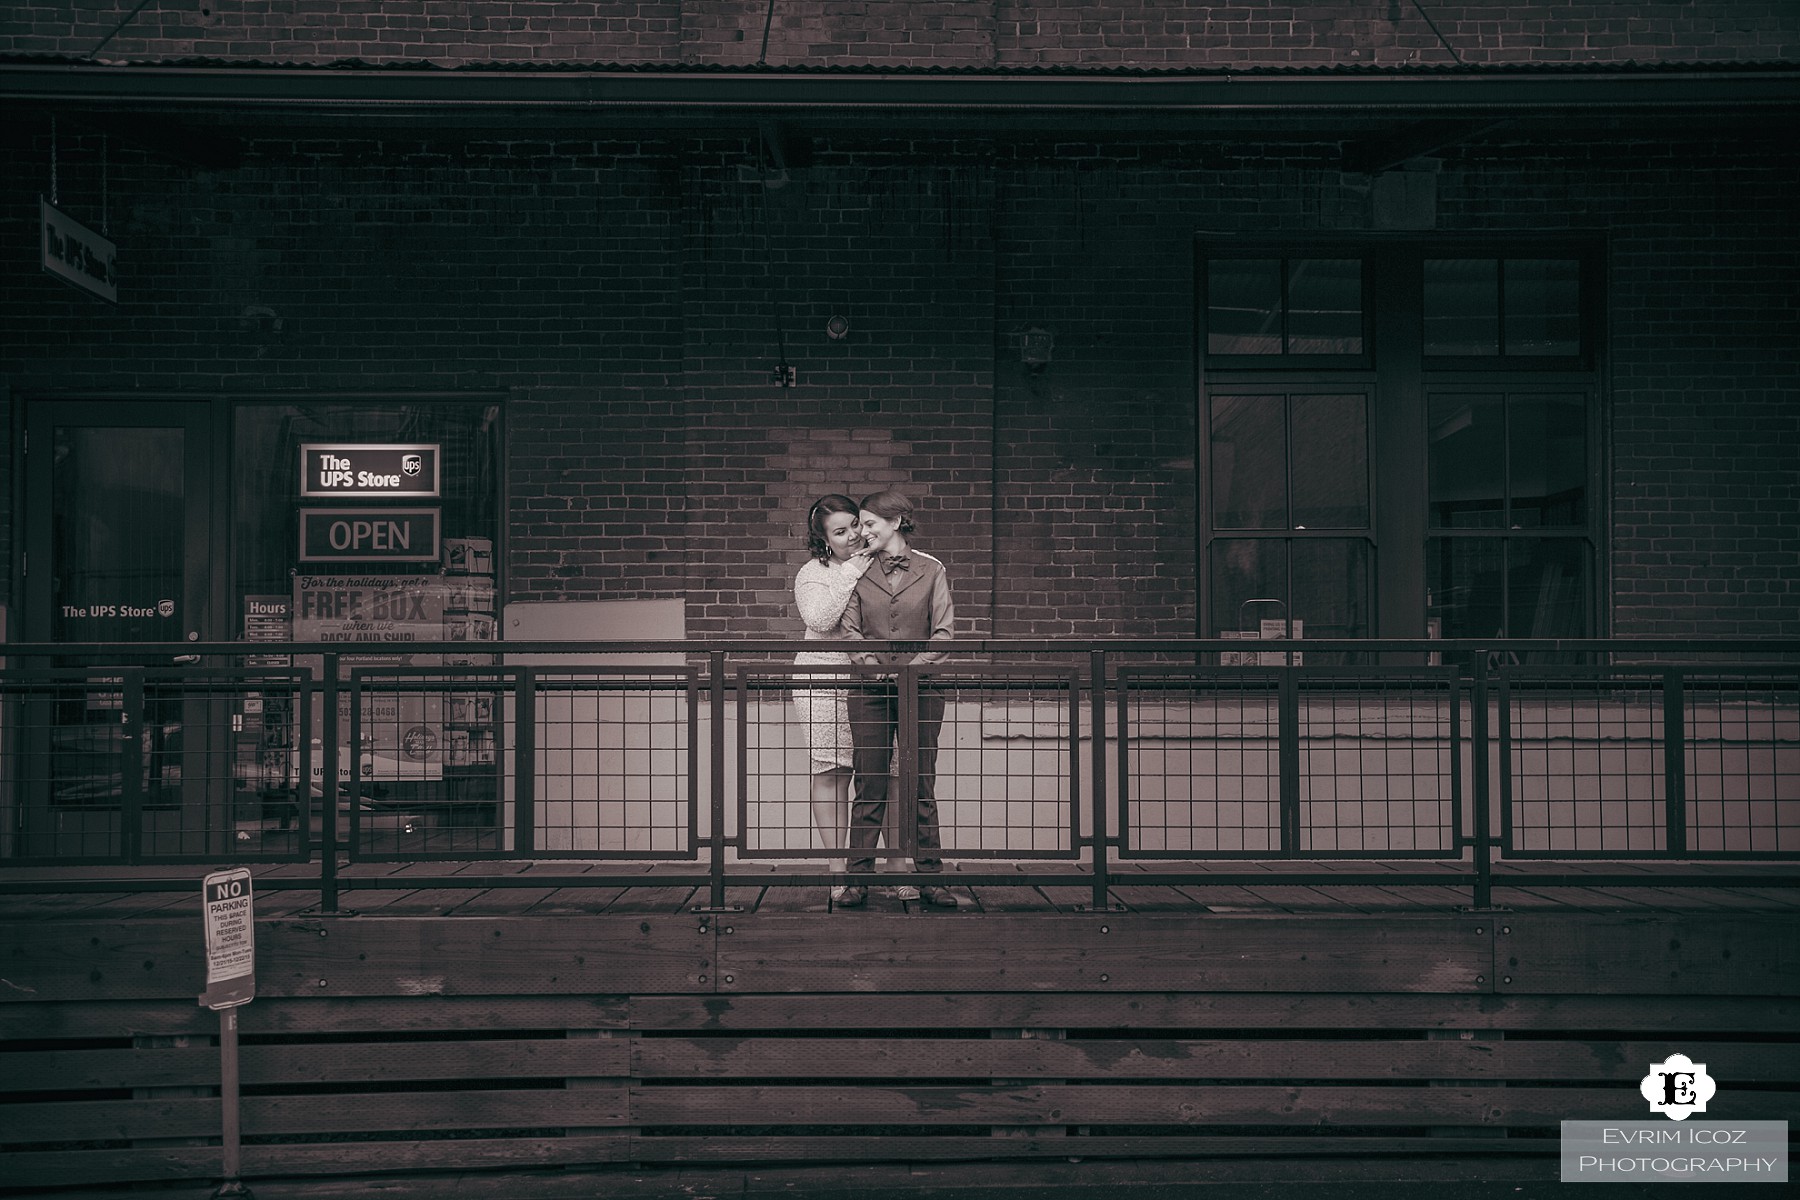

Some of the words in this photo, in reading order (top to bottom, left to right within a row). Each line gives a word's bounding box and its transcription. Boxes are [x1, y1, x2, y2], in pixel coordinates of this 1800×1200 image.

[320, 454, 350, 470] The
[402, 457, 421, 472] ups
[320, 472, 354, 488] UPS
[329, 521, 410, 550] OPEN
[301, 576, 324, 591] For
[326, 576, 345, 588] the
[401, 579, 420, 590] get
[63, 606, 86, 618] The
[90, 605, 116, 617] UPS
[160, 604, 173, 613] ups
[250, 602, 286, 615] Hours
[302, 591, 363, 620] FREE
[372, 591, 427, 620] BOX
[343, 620, 376, 631] when
[376, 622, 394, 631] we
[321, 633, 352, 642] PACK
[356, 633, 382, 642] AND
[217, 882, 241, 900] NO
[211, 899, 248, 914] PARKING
[214, 914, 228, 922] THIS
[229, 910, 247, 919] SPACE
[220, 918, 242, 928] DURING
[216, 925, 247, 936] RESERVED
[222, 934, 242, 943] HOURS
